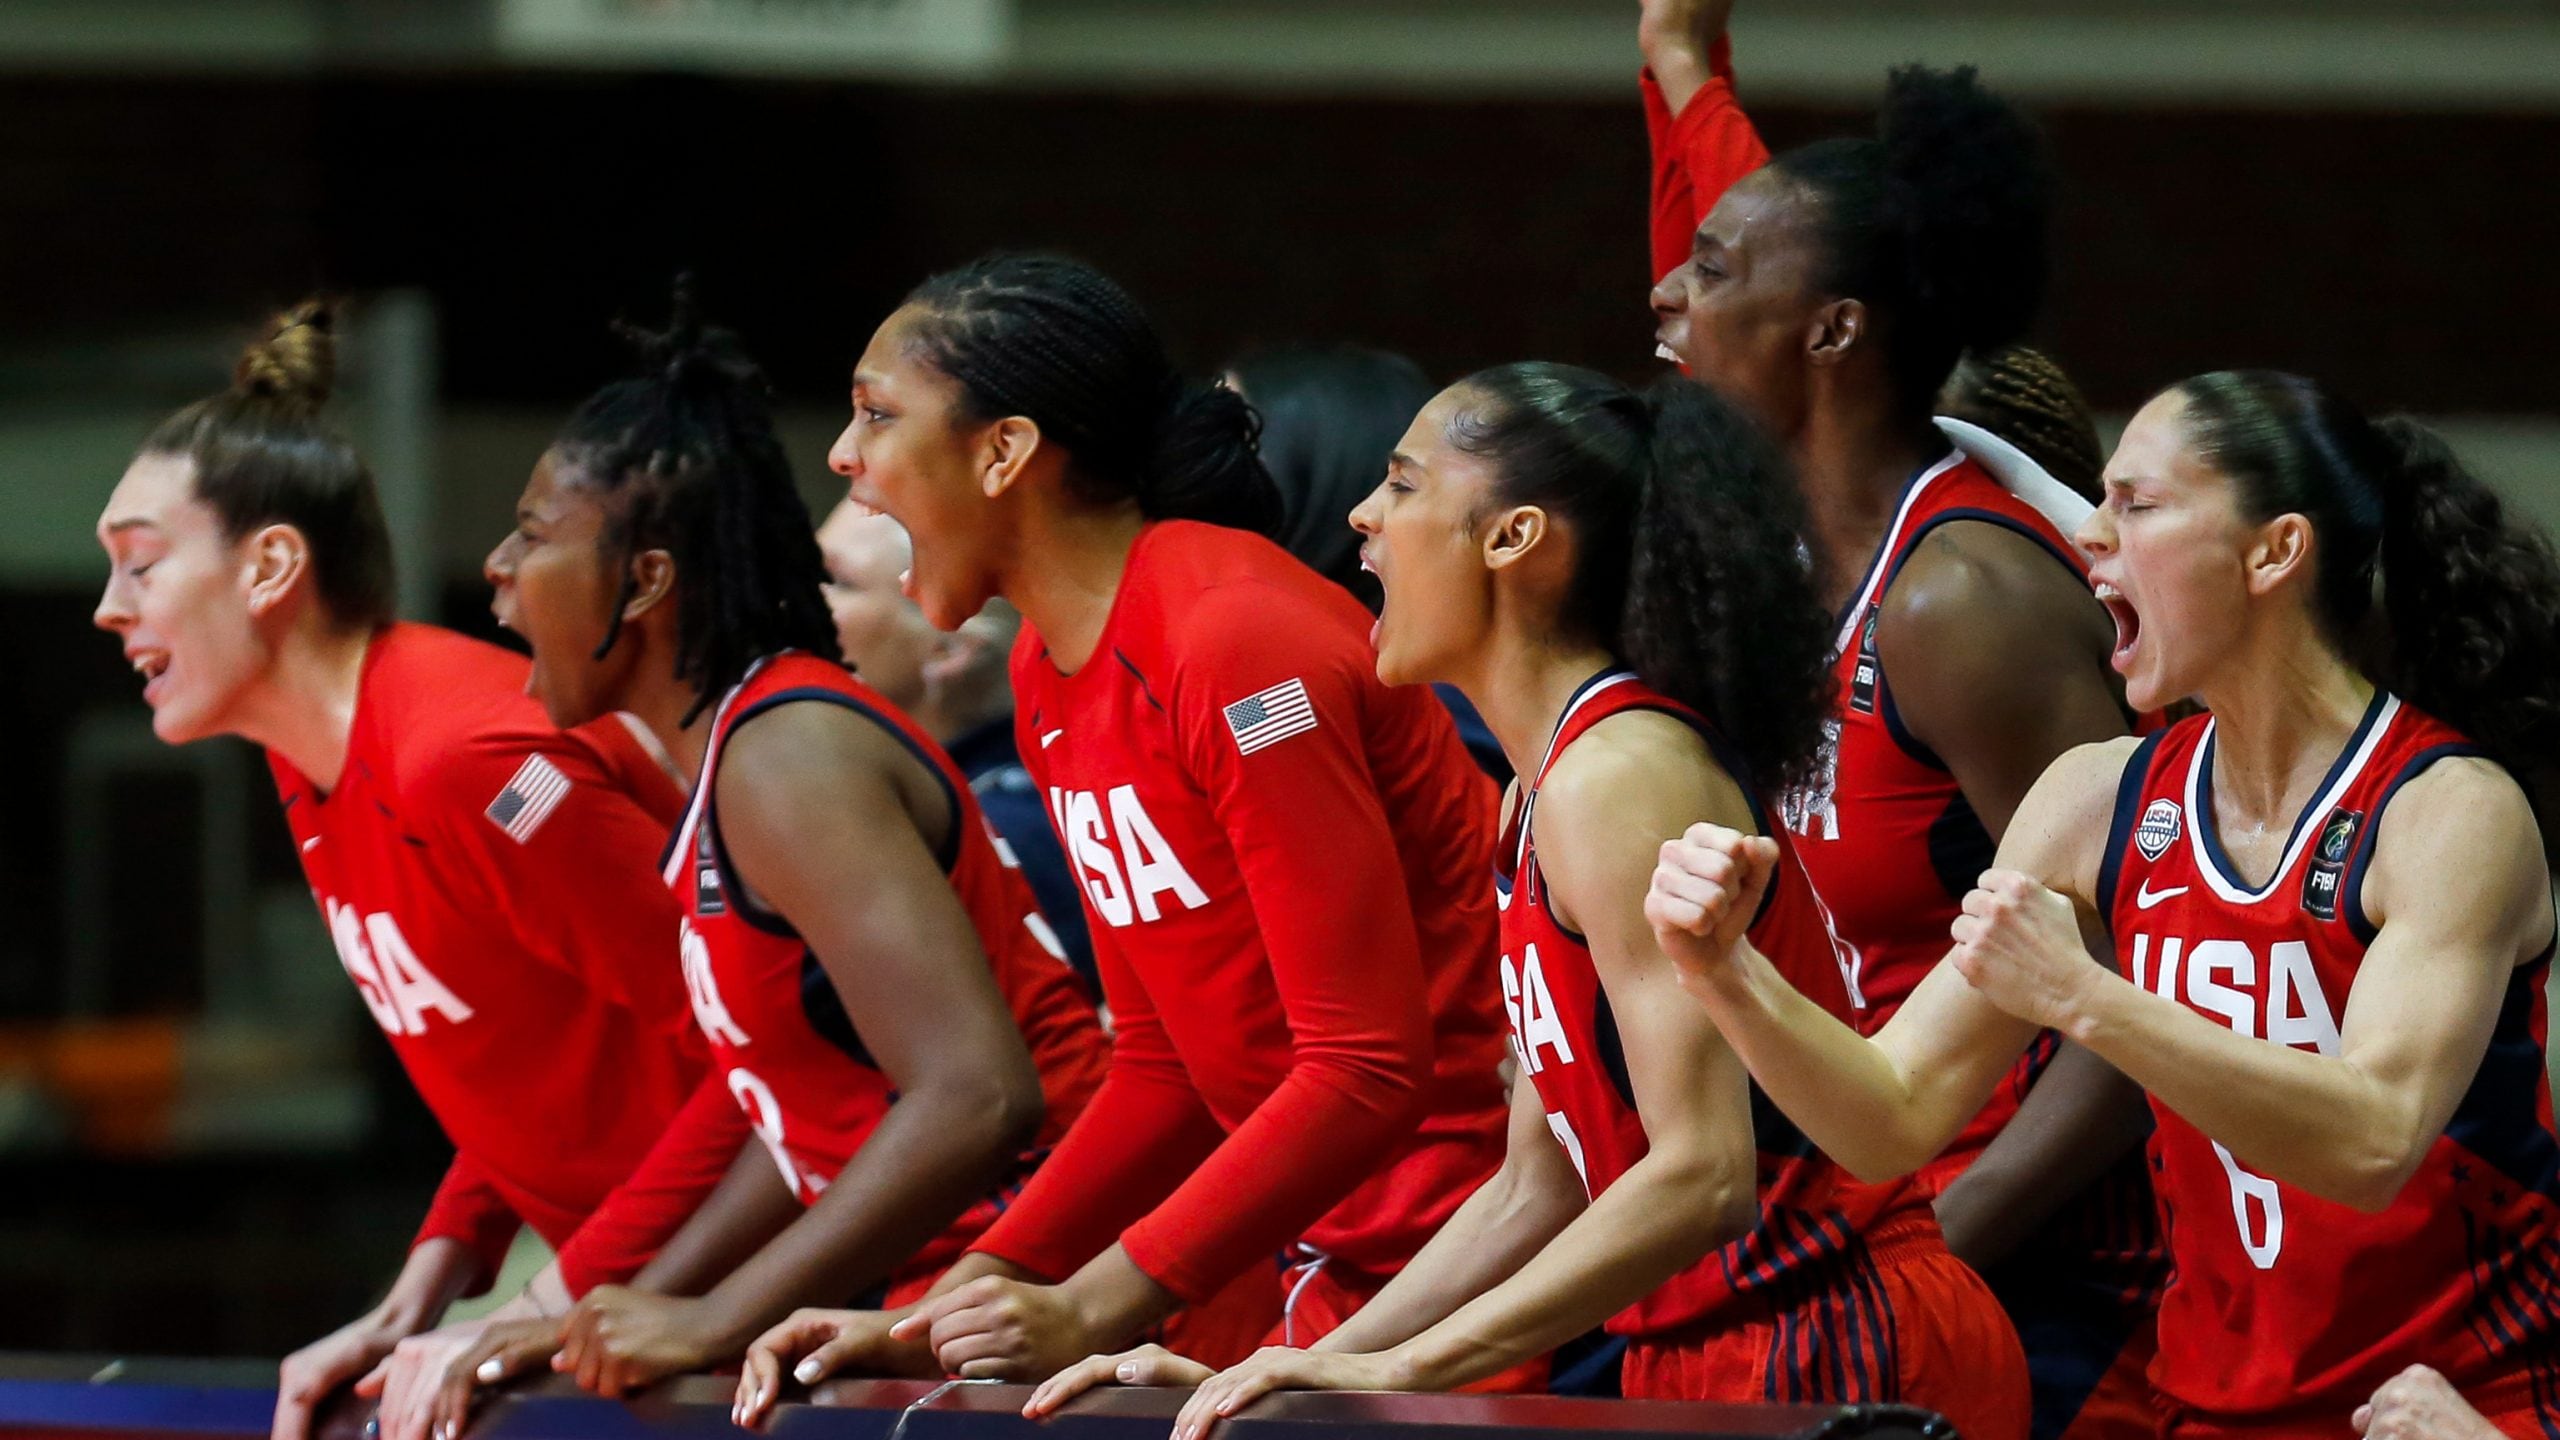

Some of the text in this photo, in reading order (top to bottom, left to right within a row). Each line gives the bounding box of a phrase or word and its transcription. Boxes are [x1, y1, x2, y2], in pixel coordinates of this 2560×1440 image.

[1049, 784, 1211, 927] USA
[1500, 942, 1575, 1077] SA
[2211, 1138, 2284, 1270] 6
